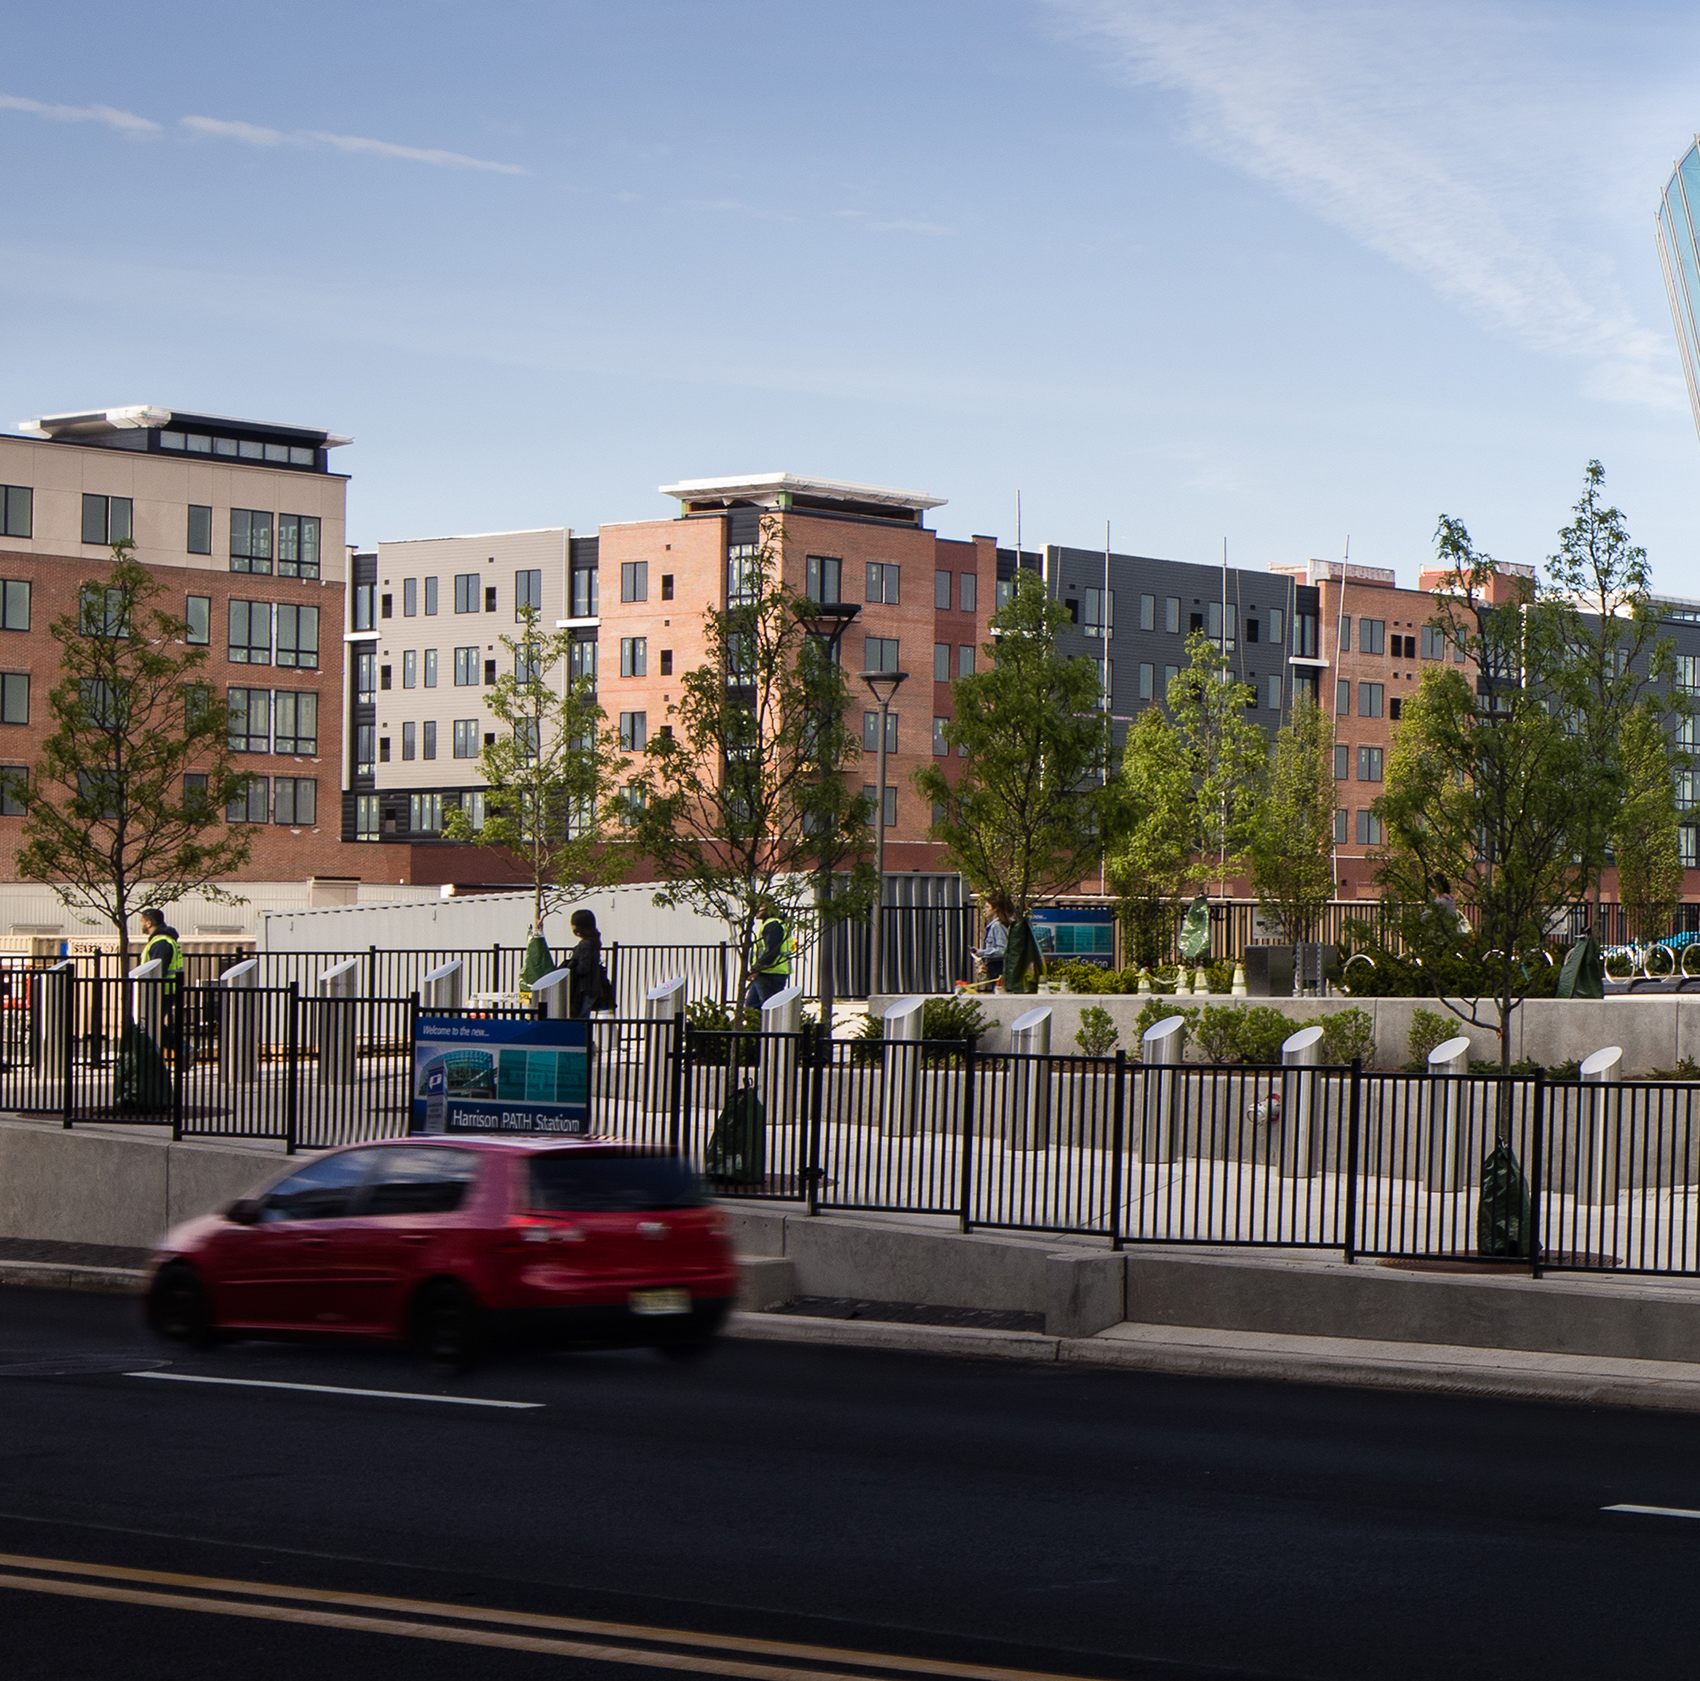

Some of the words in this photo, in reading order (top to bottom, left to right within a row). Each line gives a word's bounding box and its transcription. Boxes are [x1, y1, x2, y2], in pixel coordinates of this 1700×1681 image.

[423, 1024, 451, 1035] Welcome
[452, 1027, 459, 1036] to
[460, 1025, 471, 1036] the
[453, 1109, 499, 1128] Harrison
[502, 1112, 532, 1131] PATH
[535, 1114, 580, 1132] Station
